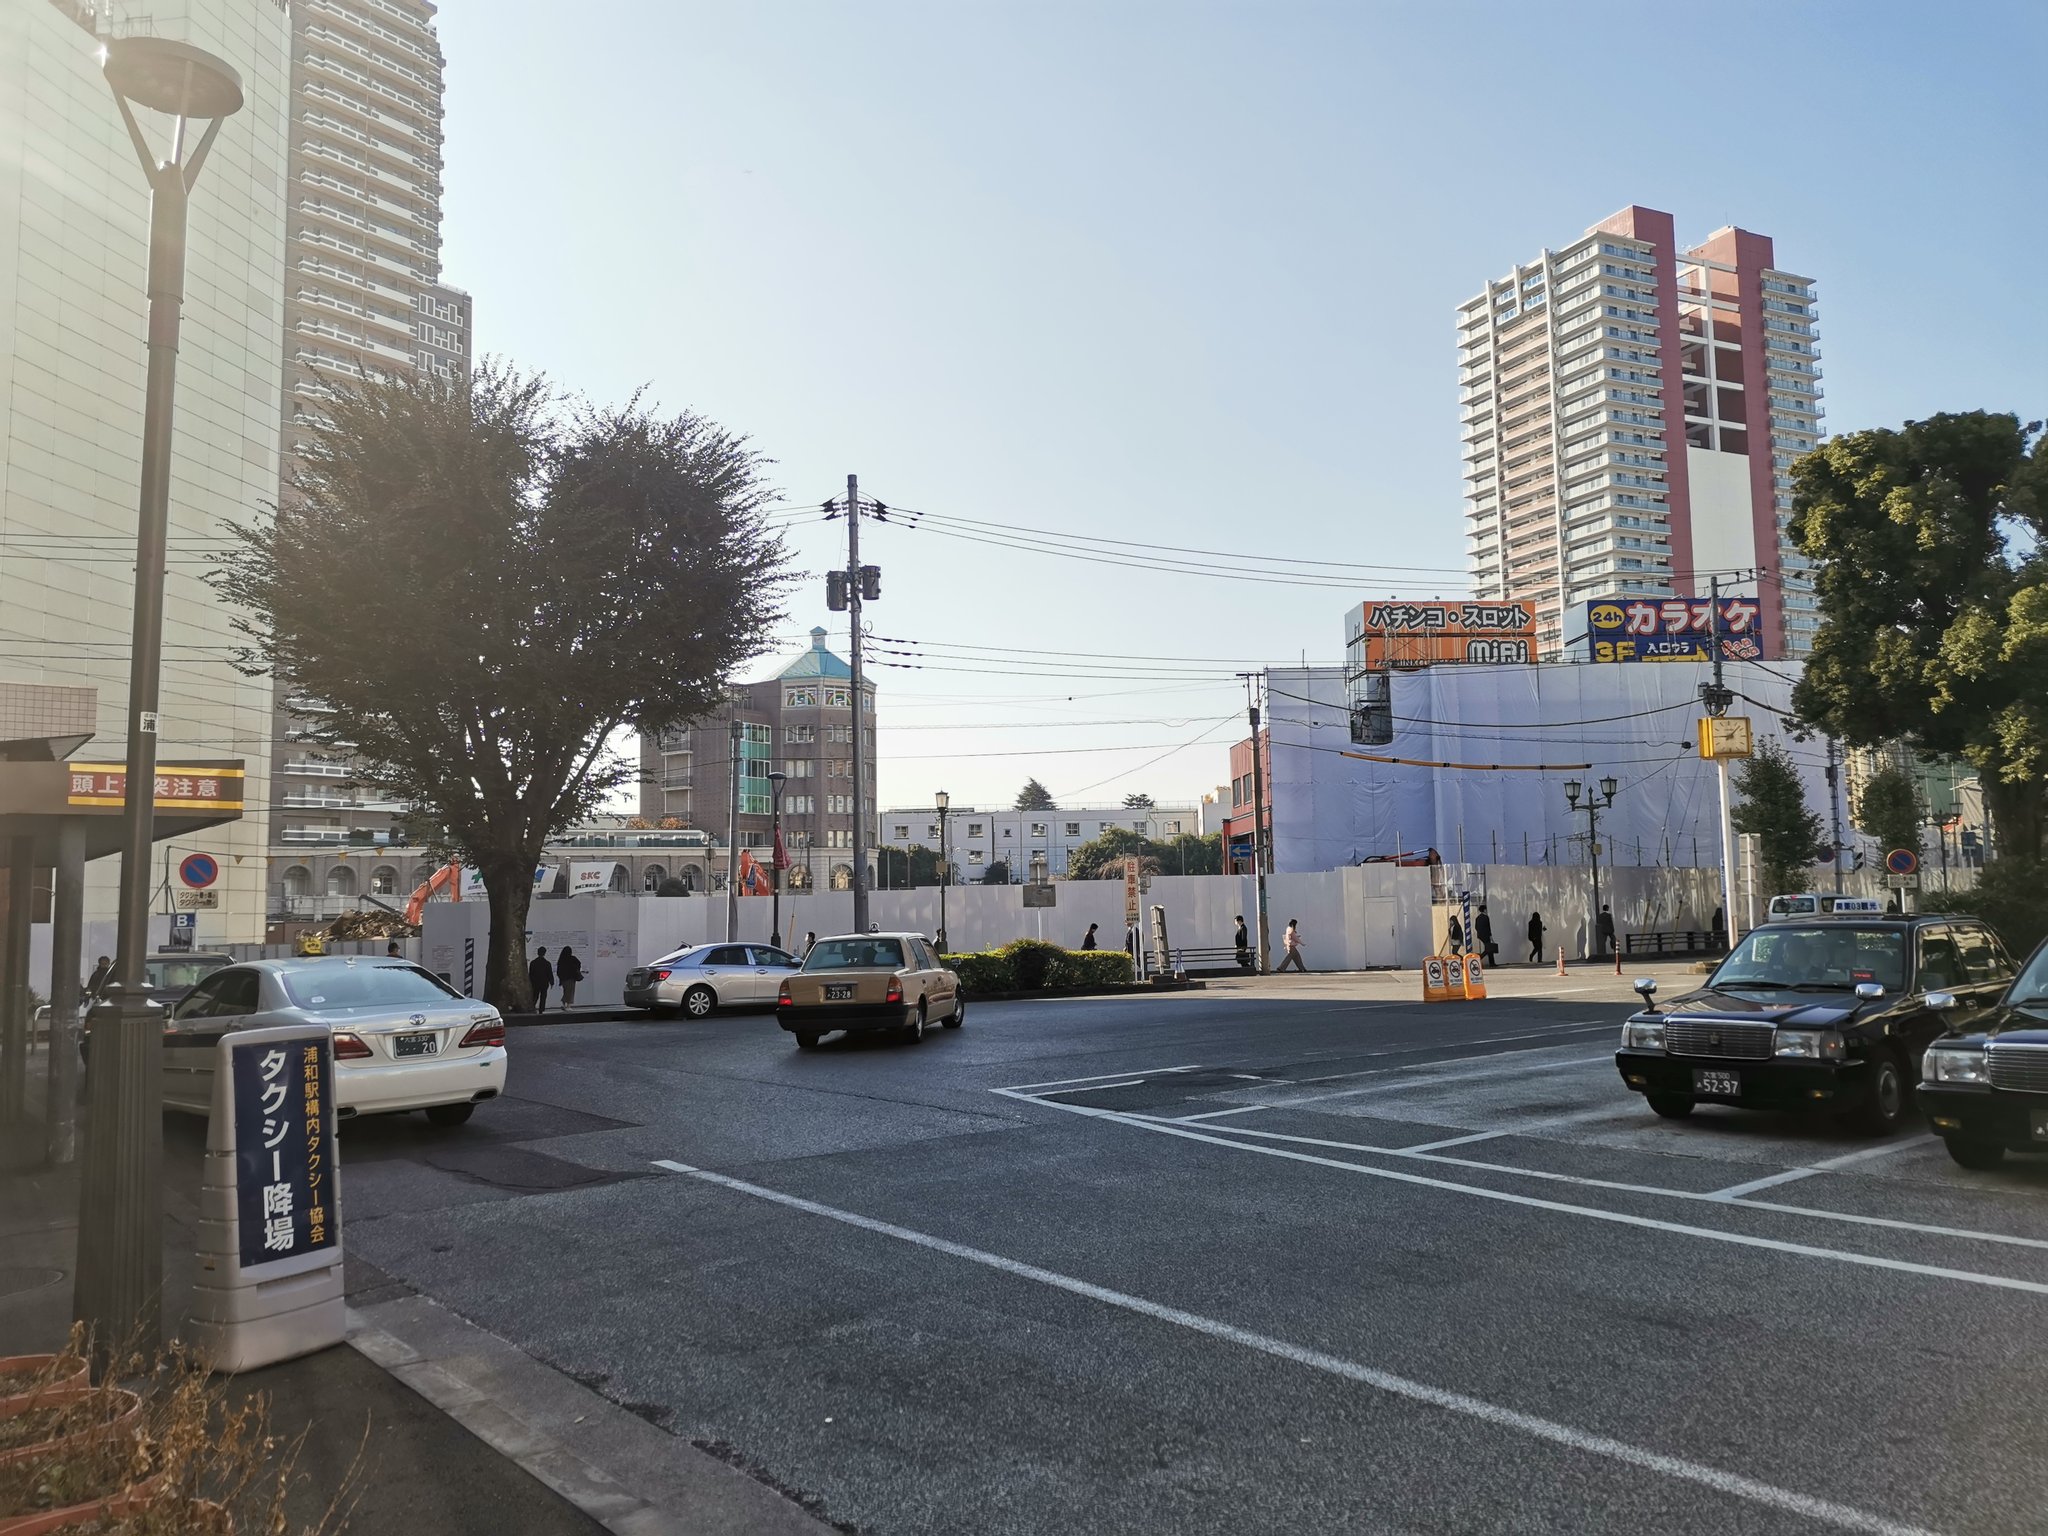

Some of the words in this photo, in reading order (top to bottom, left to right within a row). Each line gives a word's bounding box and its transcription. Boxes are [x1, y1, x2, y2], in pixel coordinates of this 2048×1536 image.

[1369, 604, 1531, 630] パチンコ・スロット
[1593, 611, 1623, 623] 24h
[1626, 601, 1759, 635] カラオケ
[1595, 641, 1636, 663] 3F
[1647, 641, 1690, 654] 入口ウラ
[71, 774, 218, 797] 頭上突注意
[580, 871, 601, 880] SKC
[1127, 861, 1137, 911] 駐車禁止
[176, 915, 188, 927] B
[1703, 1079, 1738, 1093] 52-97
[260, 1050, 294, 1252] タクシー降場
[303, 1046, 325, 1244] 浦和駅構内タクシー協会
